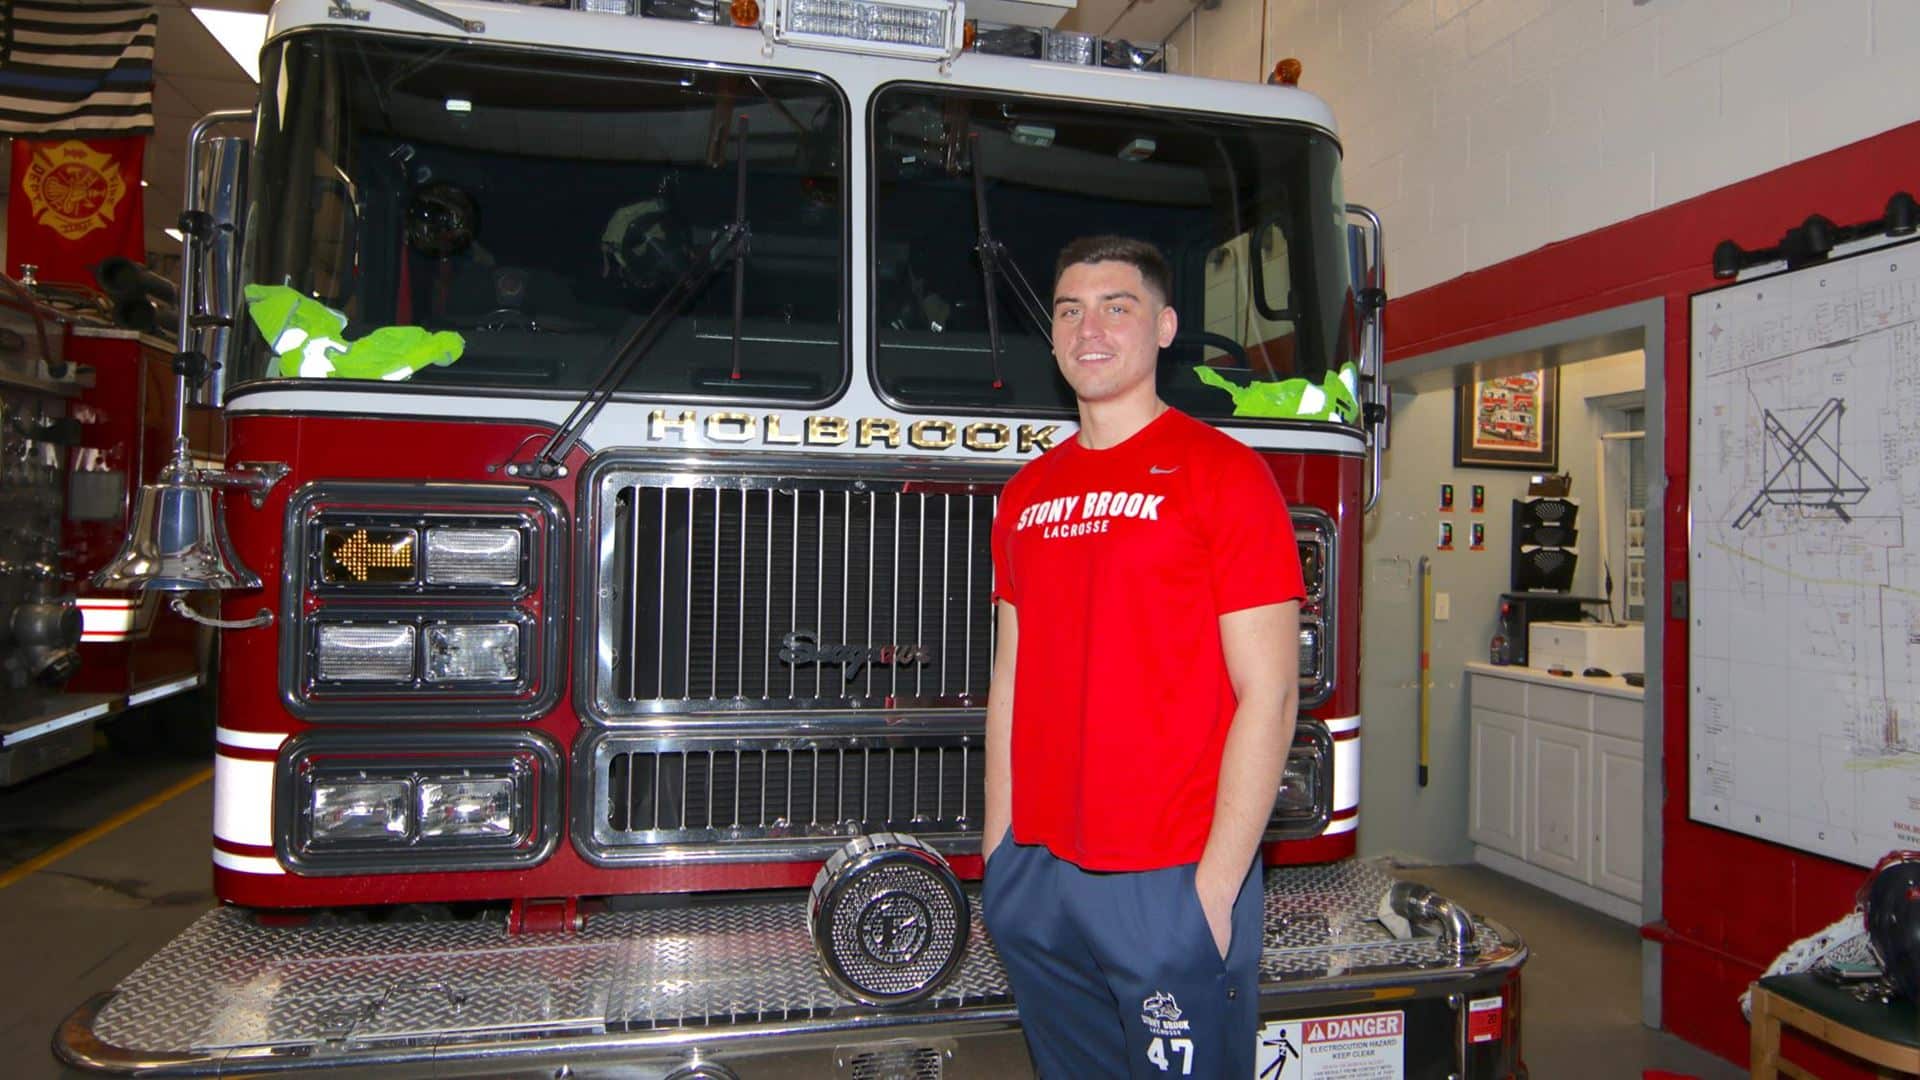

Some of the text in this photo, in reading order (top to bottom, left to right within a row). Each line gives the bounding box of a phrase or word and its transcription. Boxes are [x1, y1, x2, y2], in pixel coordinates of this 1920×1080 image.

[647, 408, 1062, 453] HOLBROOK
[1016, 491, 1165, 532] STONY BROOK
[1043, 519, 1110, 539] LACROSSE
[1327, 1016, 1398, 1039] DANGER
[1147, 1037, 1194, 1075] 47
[1310, 1039, 1397, 1053] ELECTROCUTION HAZARD
[1332, 1050, 1376, 1060] KEEP CLEAR
